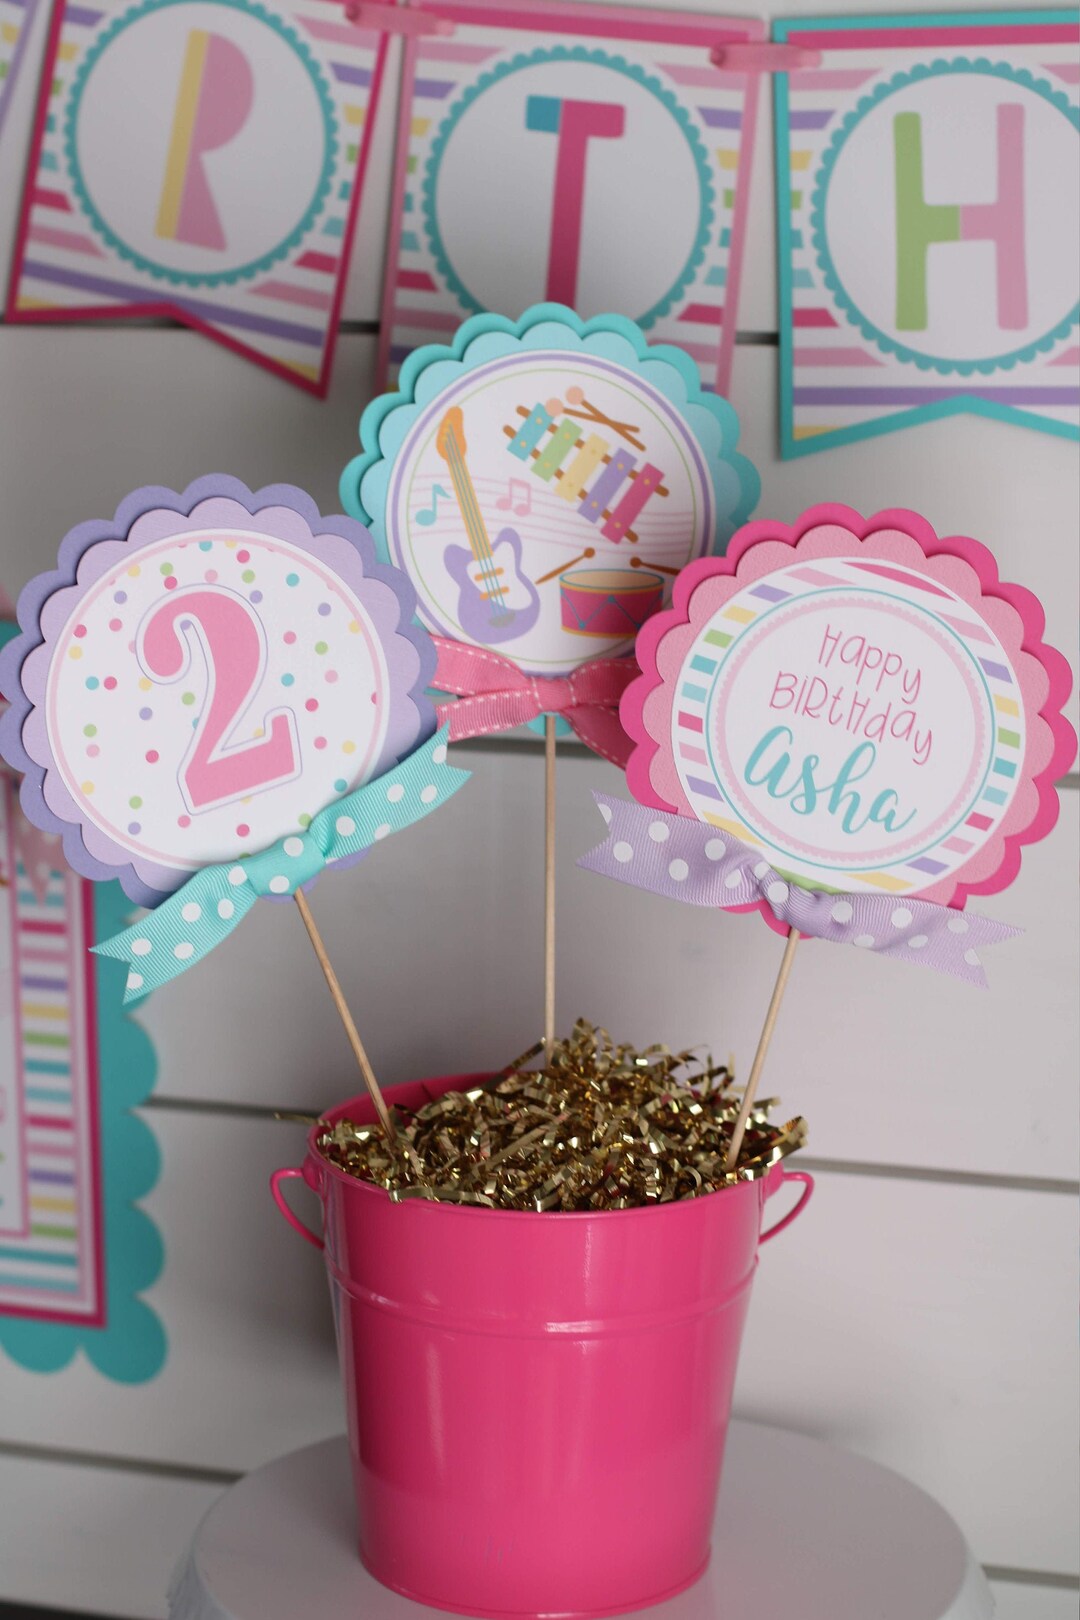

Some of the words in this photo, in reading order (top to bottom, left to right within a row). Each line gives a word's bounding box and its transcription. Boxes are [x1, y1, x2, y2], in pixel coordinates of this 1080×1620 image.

[154, 28, 255, 252] R
[525, 95, 626, 312] T
[893, 102, 1029, 331] H
[143, 591, 295, 807] 2
[818, 624, 921, 704] Happy
